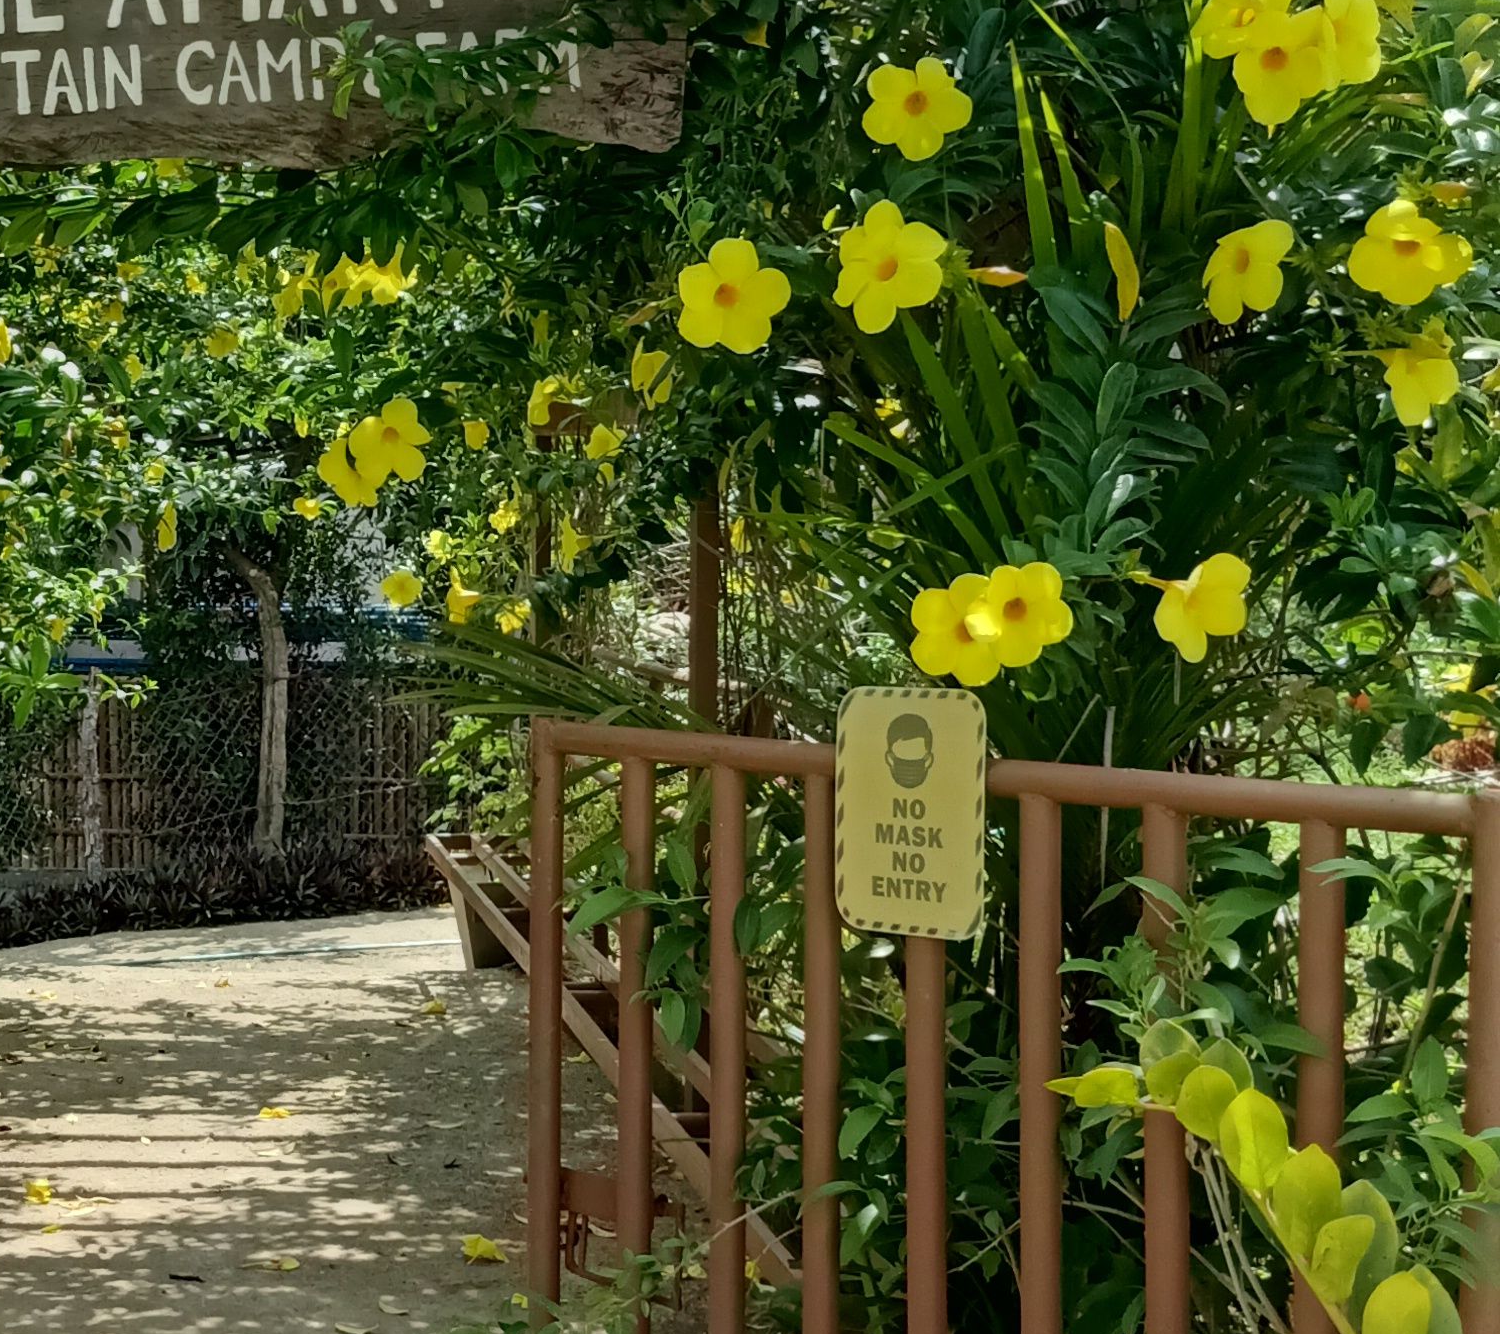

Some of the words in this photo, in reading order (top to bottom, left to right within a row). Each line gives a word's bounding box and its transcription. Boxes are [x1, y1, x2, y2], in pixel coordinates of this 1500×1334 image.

[176, 35, 346, 105] CAMP
[893, 798, 926, 820] NO
[875, 823, 943, 849] MASK
[892, 851, 926, 874] NO
[872, 875, 947, 903] ENTRY
